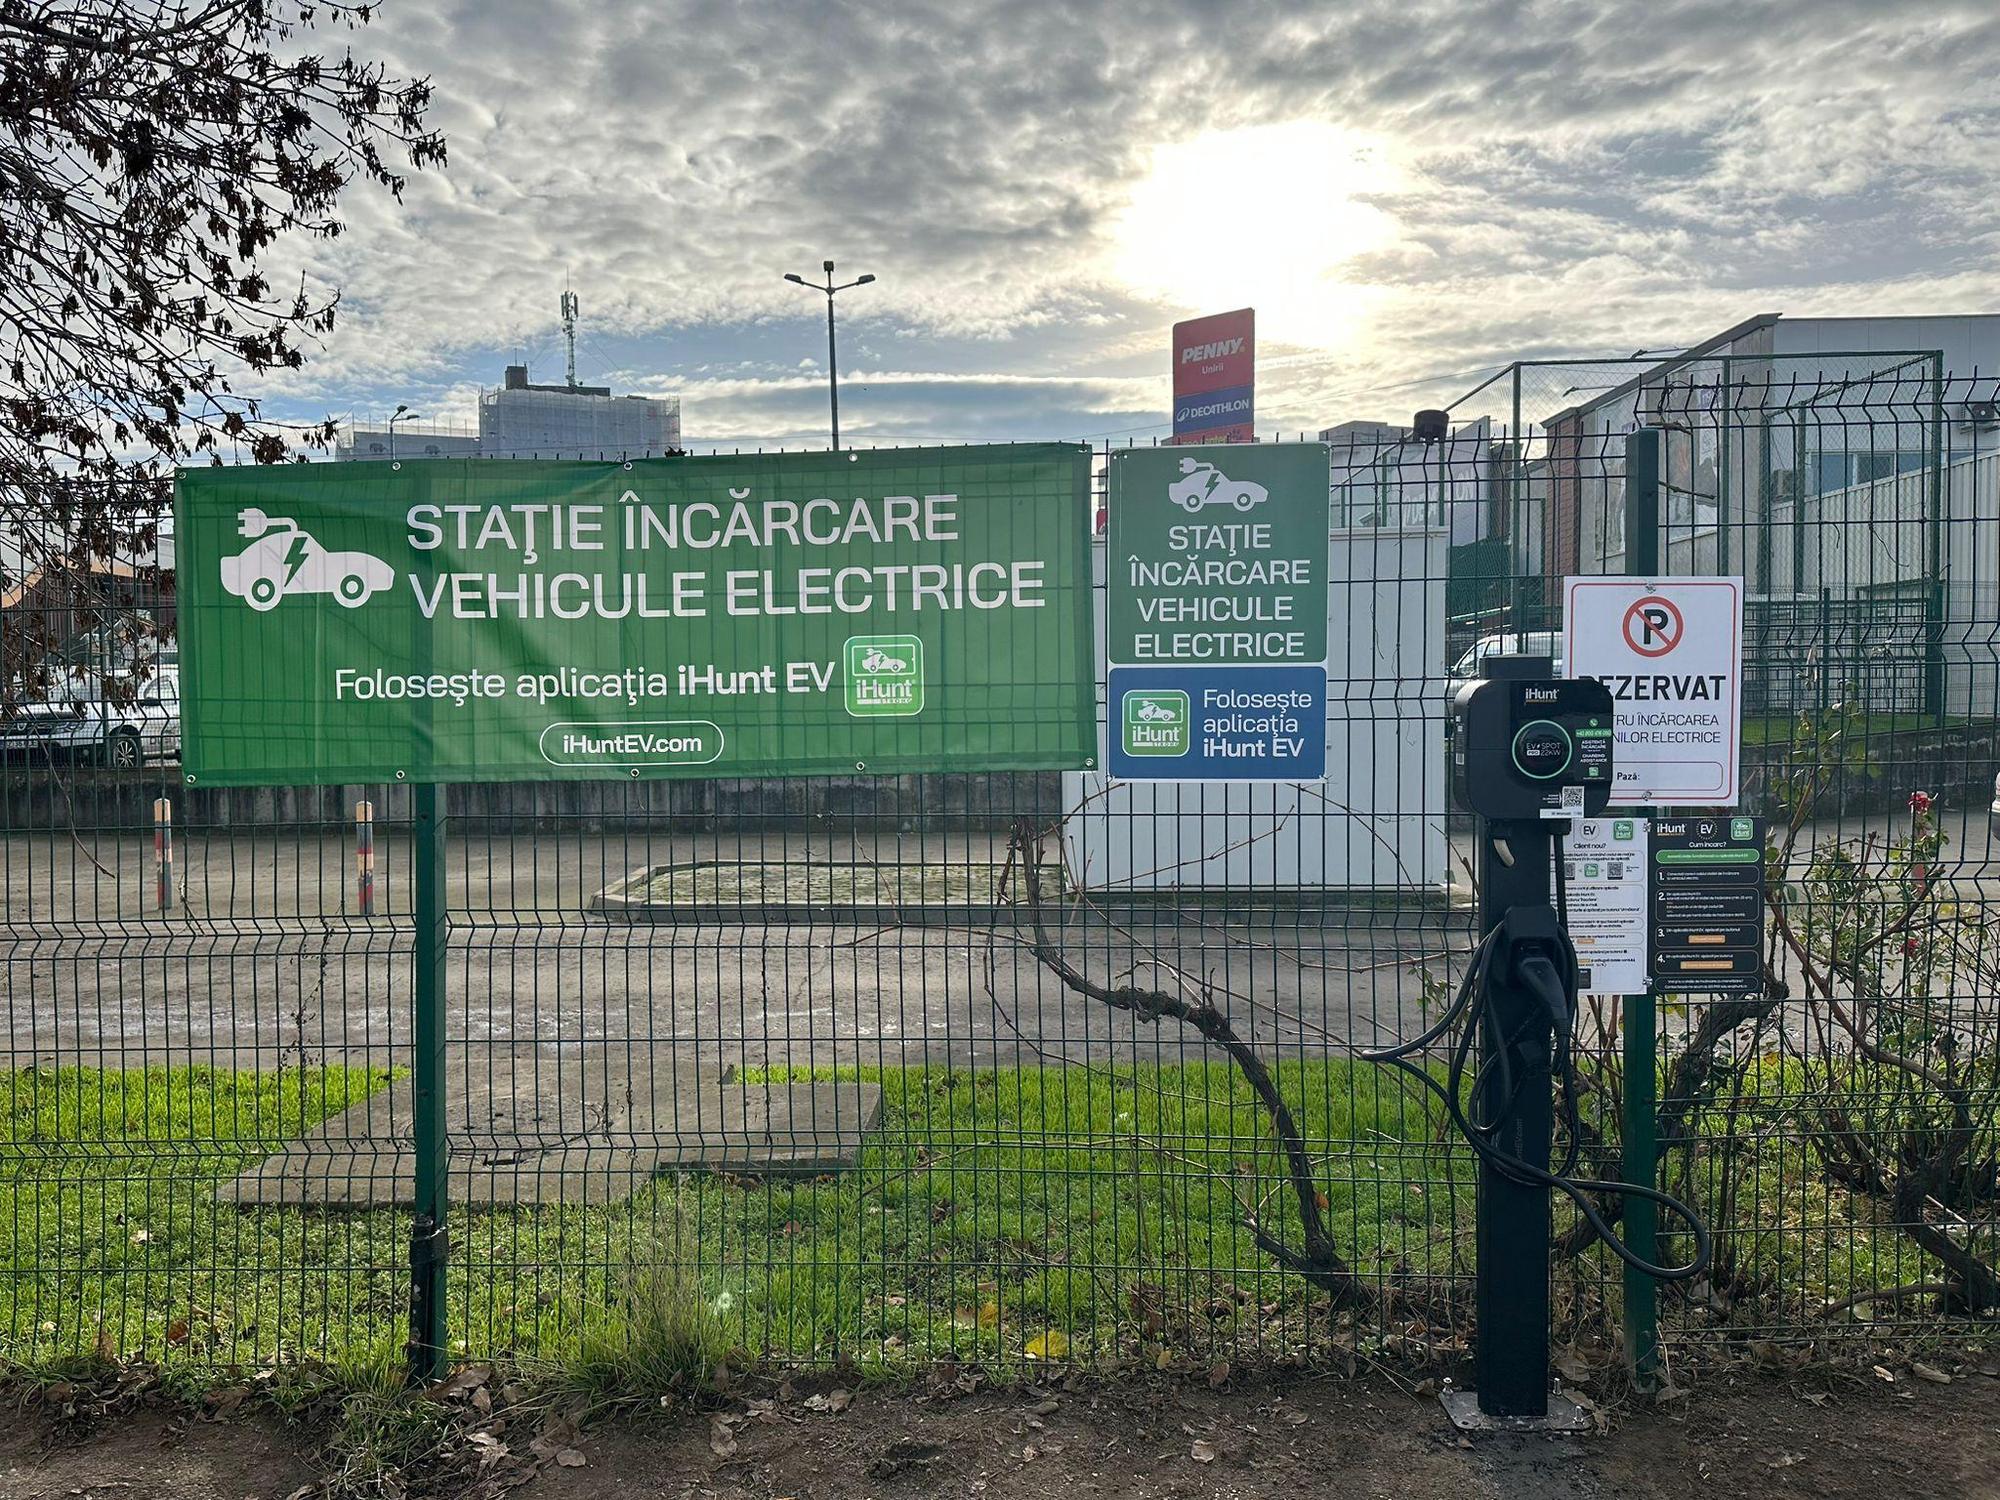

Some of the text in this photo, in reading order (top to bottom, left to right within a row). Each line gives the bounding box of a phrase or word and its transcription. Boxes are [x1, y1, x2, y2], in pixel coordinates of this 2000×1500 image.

[1190, 399, 1250, 418] DECATHLON
[618, 487, 959, 550] ÎNCĂRCARE
[1128, 554, 1311, 587] ÎNCĂRCARE
[408, 561, 1046, 619] VEHICULE ELECTRICE
[1137, 596, 1294, 622] VEHICULE
[1134, 632, 1305, 658] ELECTRICE
[678, 664, 777, 696] iHunt
[786, 661, 836, 693] EV
[1579, 675, 1727, 701] EZERVAT
[856, 679, 913, 698] iHunt
[1525, 688, 1558, 700] iHunt
[1637, 711, 1719, 726] ÎNCĂRCAREA
[1132, 726, 1180, 742] iHunt
[1651, 731, 1721, 744] ELECTRICE
[563, 734, 702, 754] iHuntEV.com
[1203, 738, 1305, 758] iHunt EV
[1541, 742, 1561, 750] SPOT
[1583, 825, 1597, 835] EV
[1656, 823, 1686, 833] iHunt
[1700, 824, 1713, 834] EV
